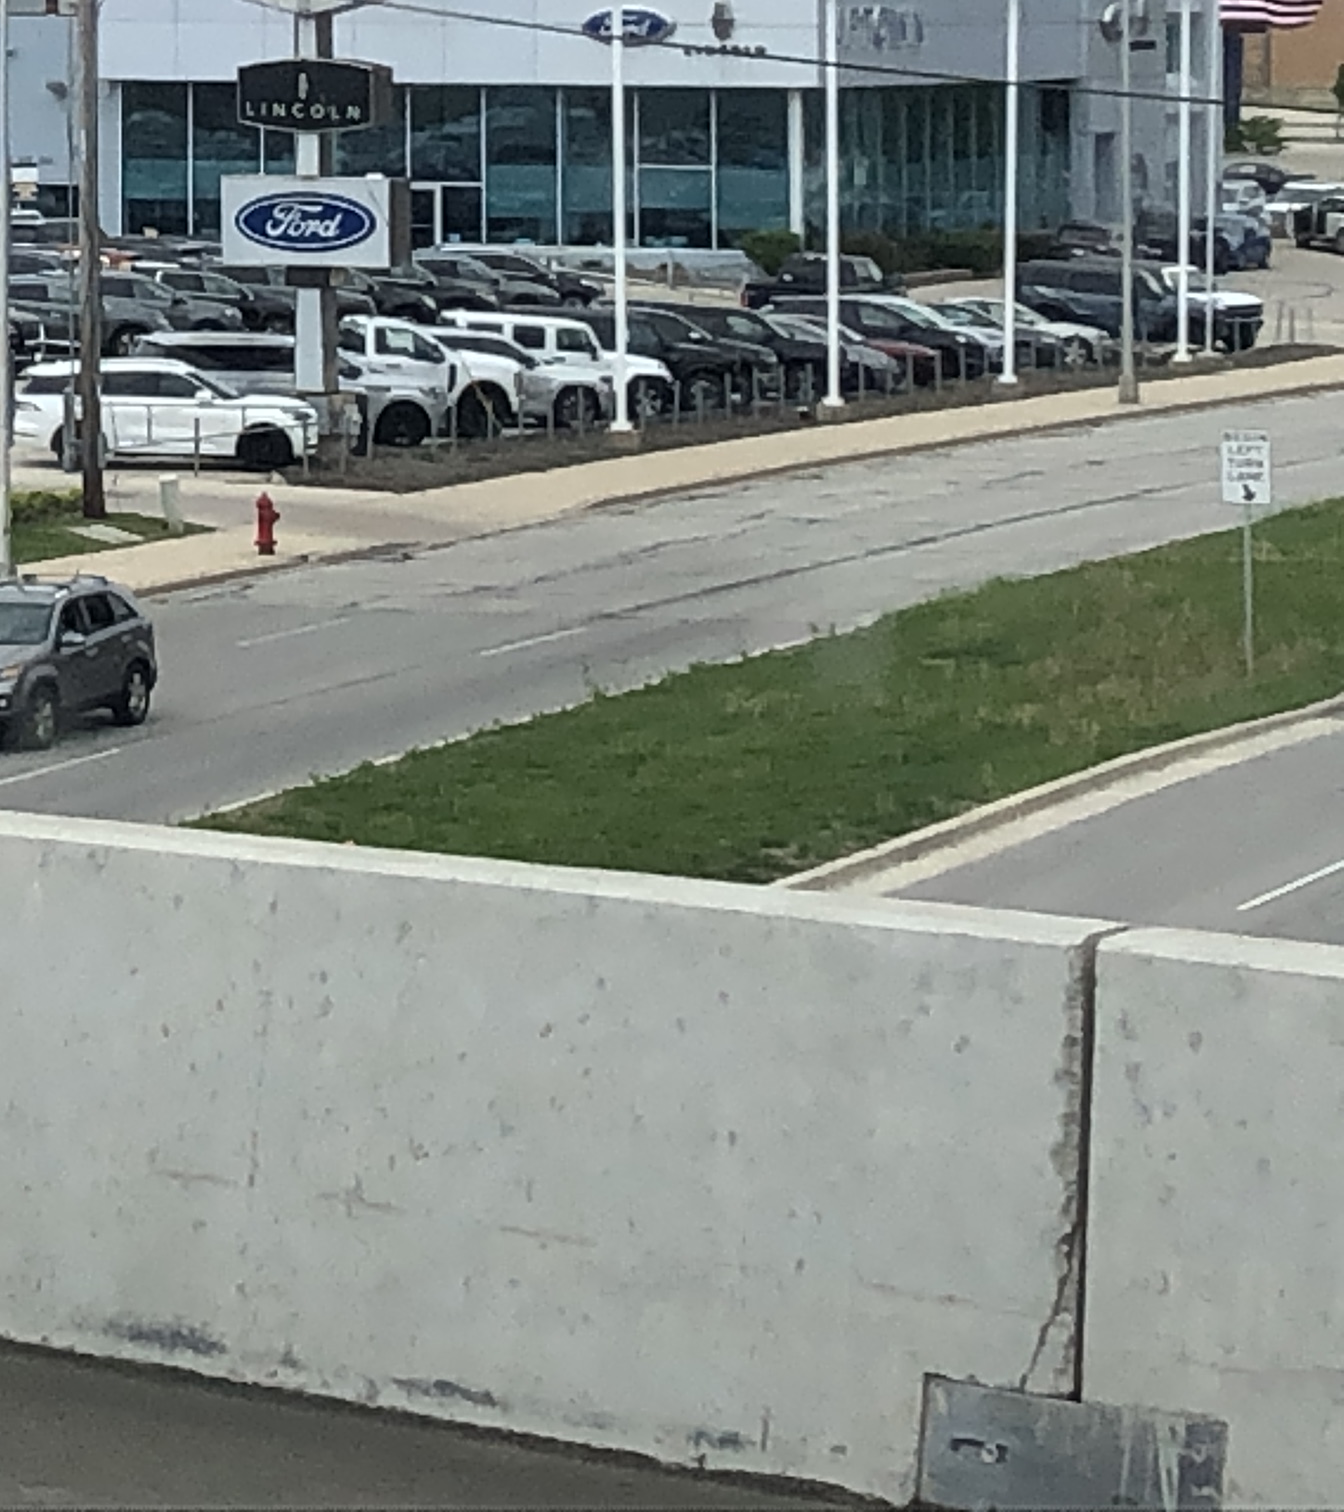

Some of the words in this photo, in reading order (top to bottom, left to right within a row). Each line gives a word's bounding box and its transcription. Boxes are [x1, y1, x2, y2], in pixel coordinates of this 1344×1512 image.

[598, 14, 651, 37] Frd
[245, 100, 361, 121] LINCOLN
[265, 201, 344, 237] Ford
[1226, 445, 1264, 456] LEFT
